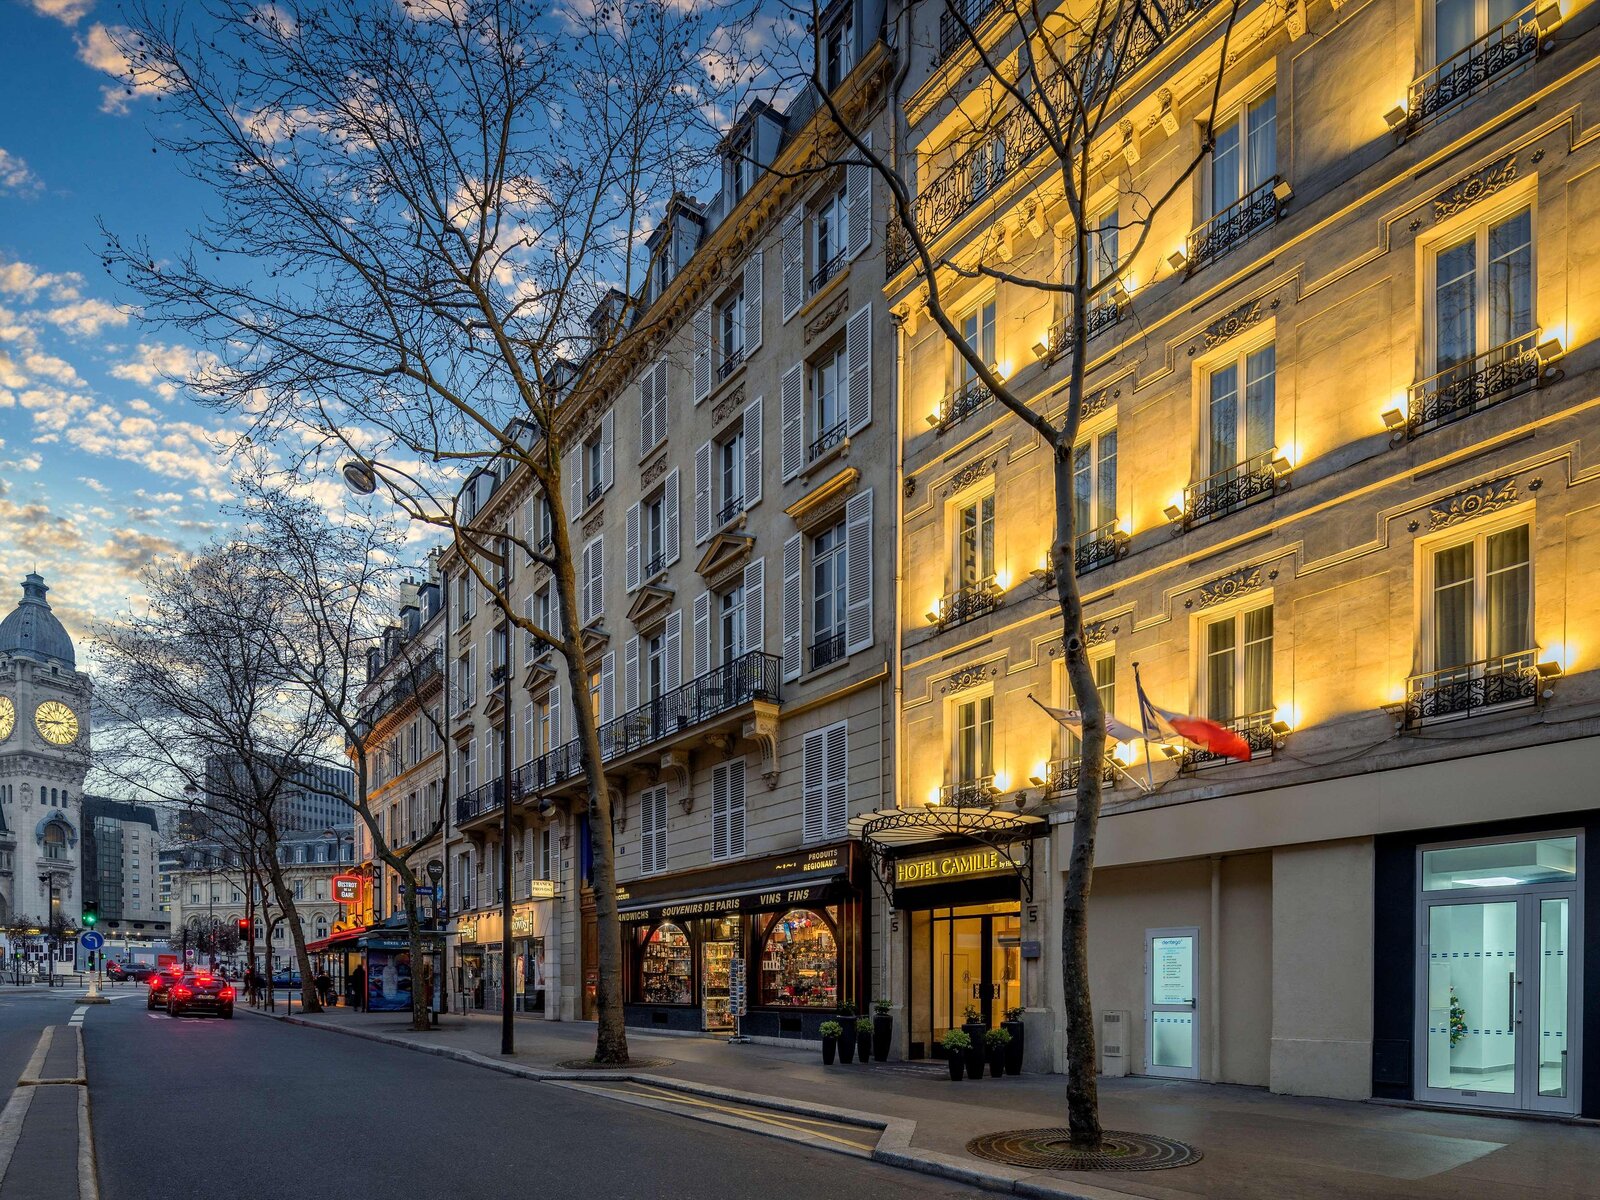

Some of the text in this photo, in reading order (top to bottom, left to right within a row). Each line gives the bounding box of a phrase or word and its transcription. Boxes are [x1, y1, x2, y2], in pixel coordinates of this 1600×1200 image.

[808, 849, 838, 860] PRODUITS
[803, 859, 838, 871] REGIONAUX
[898, 860, 938, 880] HOTEL
[941, 852, 998, 875] CAMILLE
[760, 889, 810, 905] VINS FINS
[661, 899, 740, 917] SOUVENIRS DE PARIS
[618, 910, 649, 922] ANDWICHS
[1029, 910, 1037, 922] 5
[891, 922, 898, 932] 5
